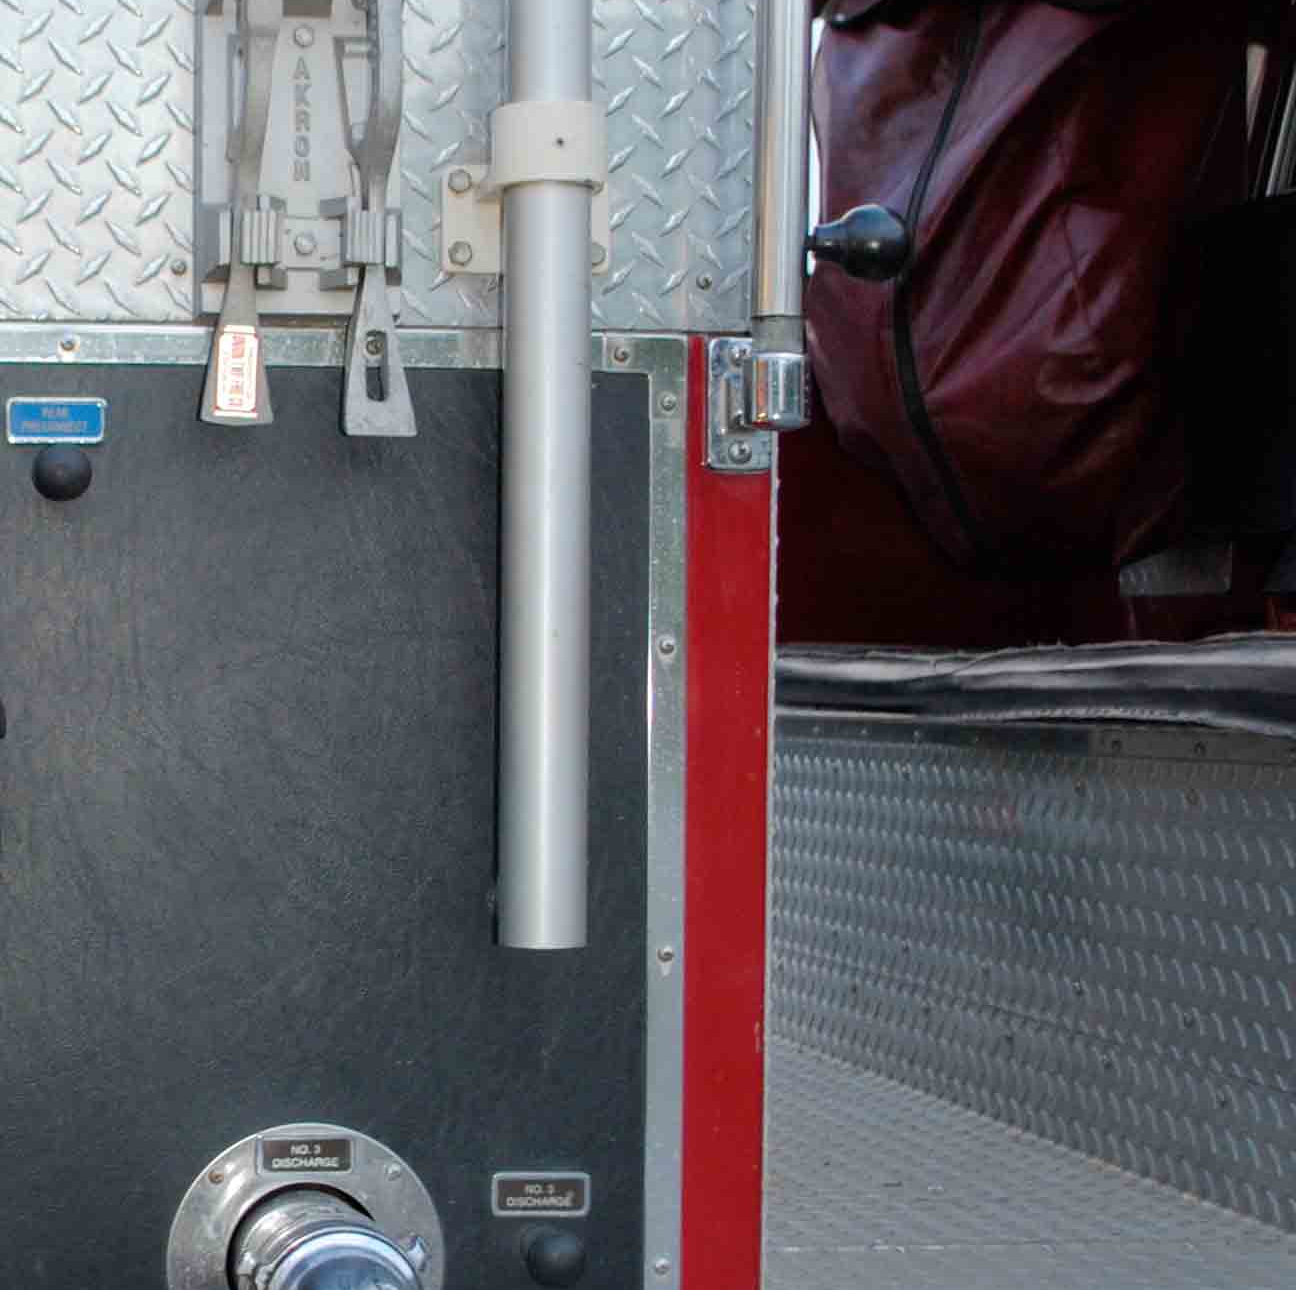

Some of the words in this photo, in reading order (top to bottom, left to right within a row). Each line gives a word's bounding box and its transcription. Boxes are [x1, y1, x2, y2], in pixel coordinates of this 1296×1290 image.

[292, 55, 312, 182] AKRON
[271, 1157, 340, 1169] DISCHARGE
[506, 1196, 573, 1207] DISCHARGE
